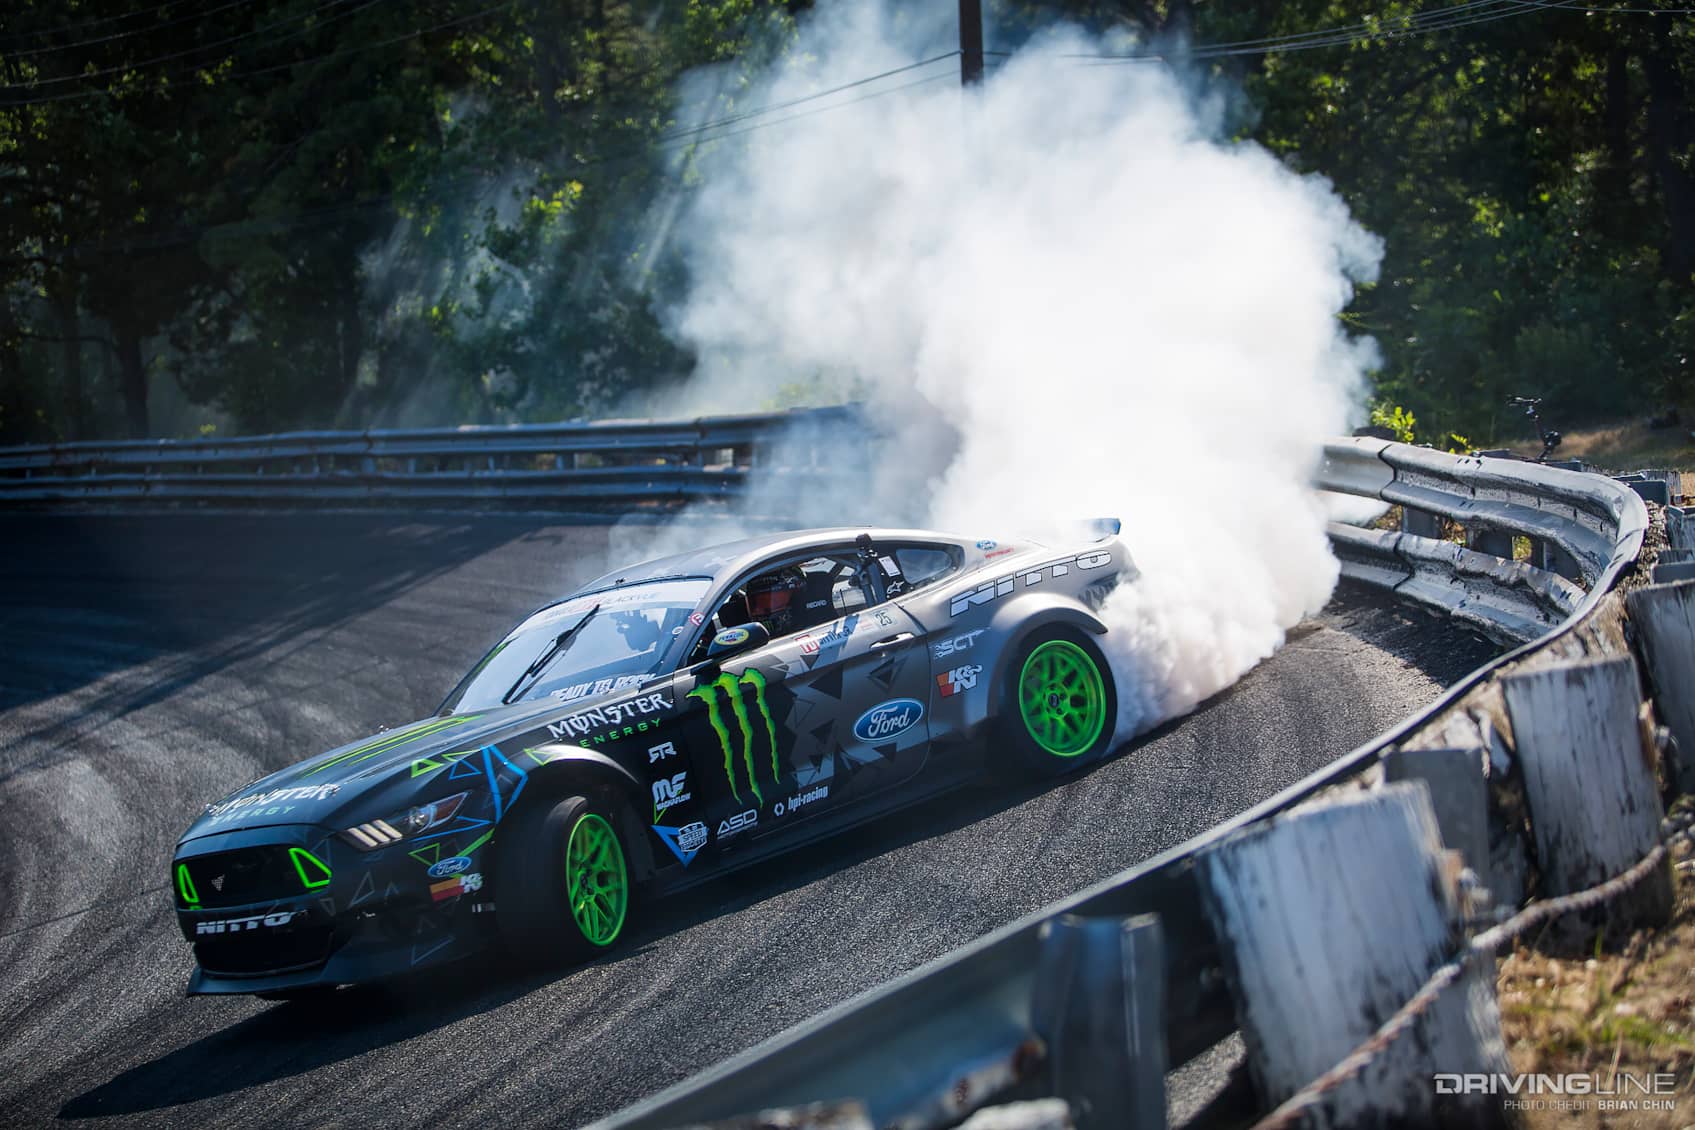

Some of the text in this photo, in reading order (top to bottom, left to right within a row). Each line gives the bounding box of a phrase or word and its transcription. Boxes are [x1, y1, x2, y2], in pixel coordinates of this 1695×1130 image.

[950, 549, 1112, 618] NITTO
[874, 611, 893, 627] 25
[935, 628, 984, 658] SCT
[546, 693, 674, 739] MONSTER
[579, 717, 661, 748] ENERGY
[787, 785, 829, 812] hpi-racing
[716, 808, 758, 835] ASD
[196, 911, 297, 935] NITTO
